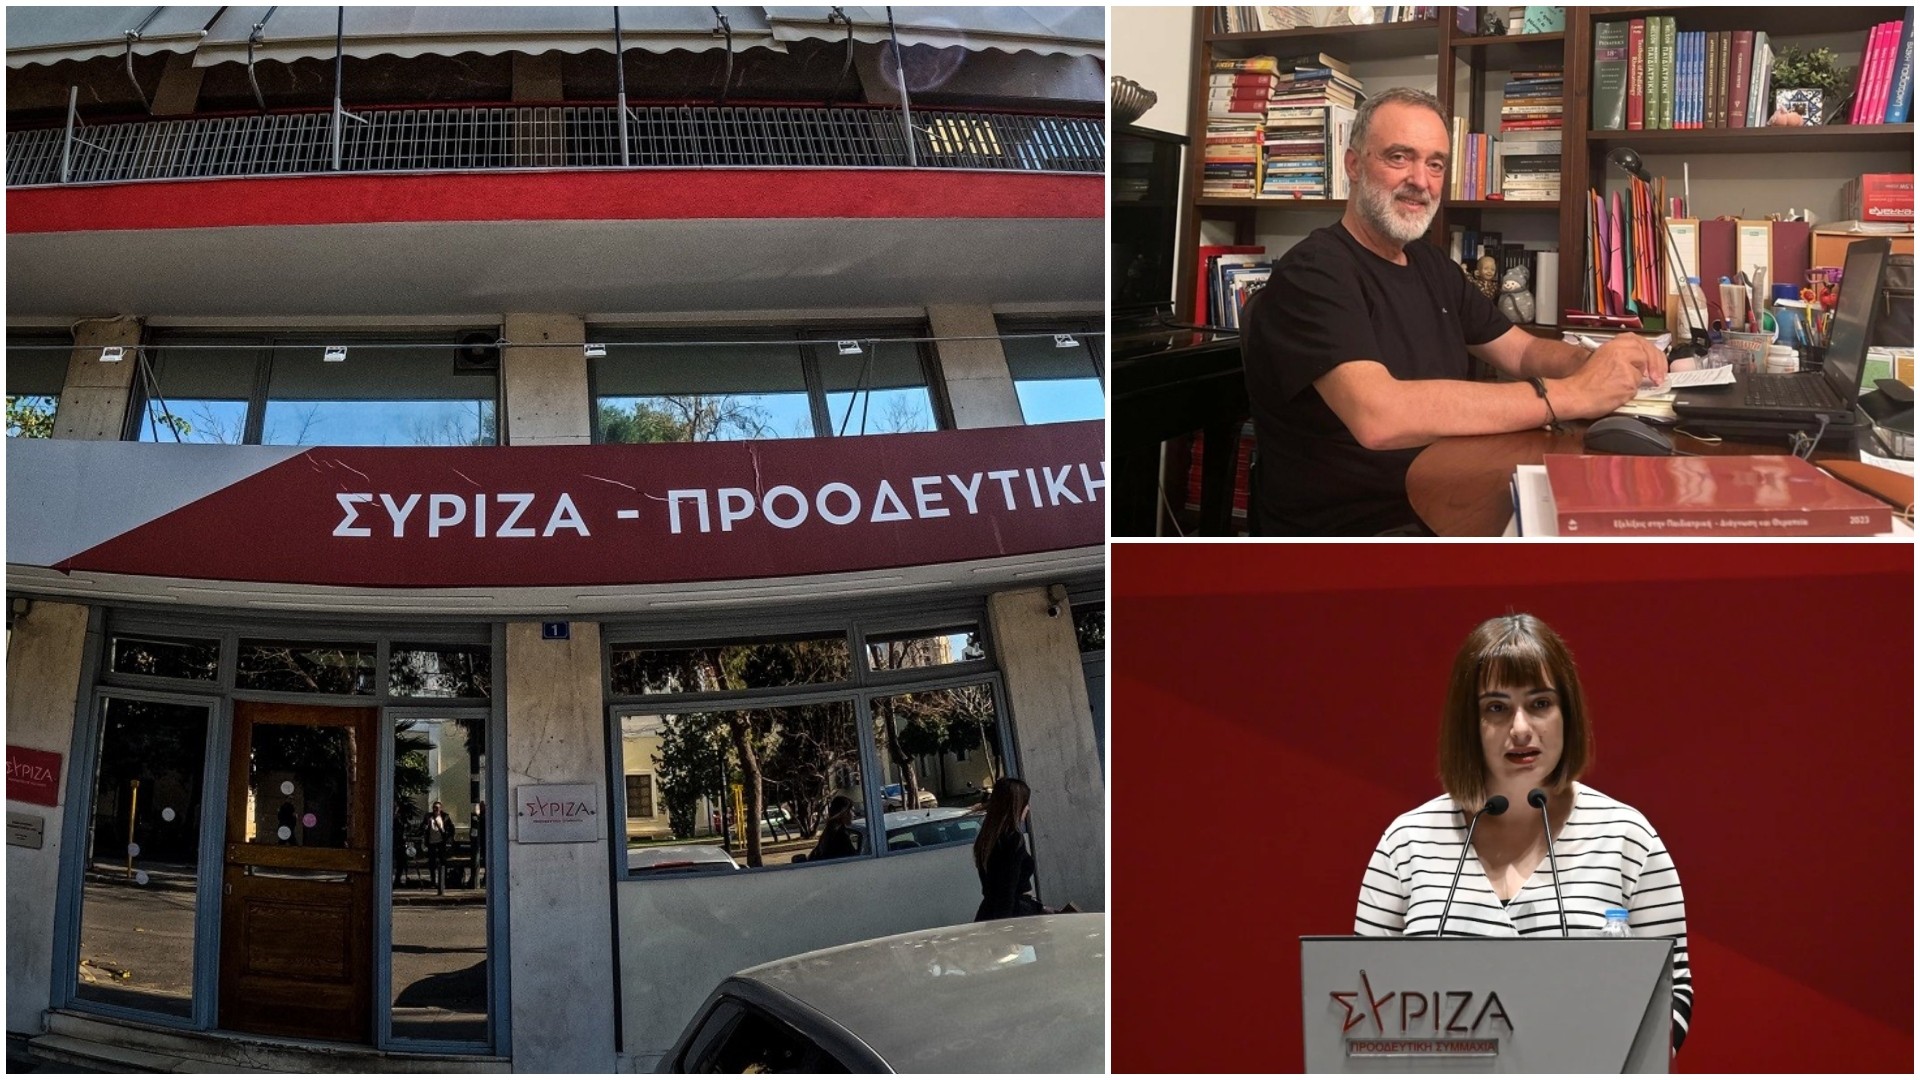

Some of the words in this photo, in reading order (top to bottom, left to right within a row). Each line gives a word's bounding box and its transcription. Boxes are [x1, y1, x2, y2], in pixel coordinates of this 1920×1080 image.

[1647, 46, 1655, 94] ΠΑΙΔΙΑΤΡΙΚΗ
[1661, 46, 1669, 94] ΠΑΙΔΙΑΤΡΙΚΗ
[332, 491, 591, 538] ΣΥΡΙΖΑ
[668, 461, 1105, 534] ΠΡΟΟΔΕΥΤΙΚΗ
[1849, 516, 1871, 525] 2023
[551, 624, 558, 636] 1
[6, 756, 54, 782] ΣΥΡΙΖΑ
[525, 795, 590, 817] ΣΥΡΙΖΑ
[1329, 968, 1514, 1032] ΣΥΡΙΖΑ
[1350, 1041, 1432, 1052] ΠΡΟΟΔΕΥΤΙΚΗ
[1435, 1041, 1496, 1052] ΣΥΜΜΑΧΙΑ
